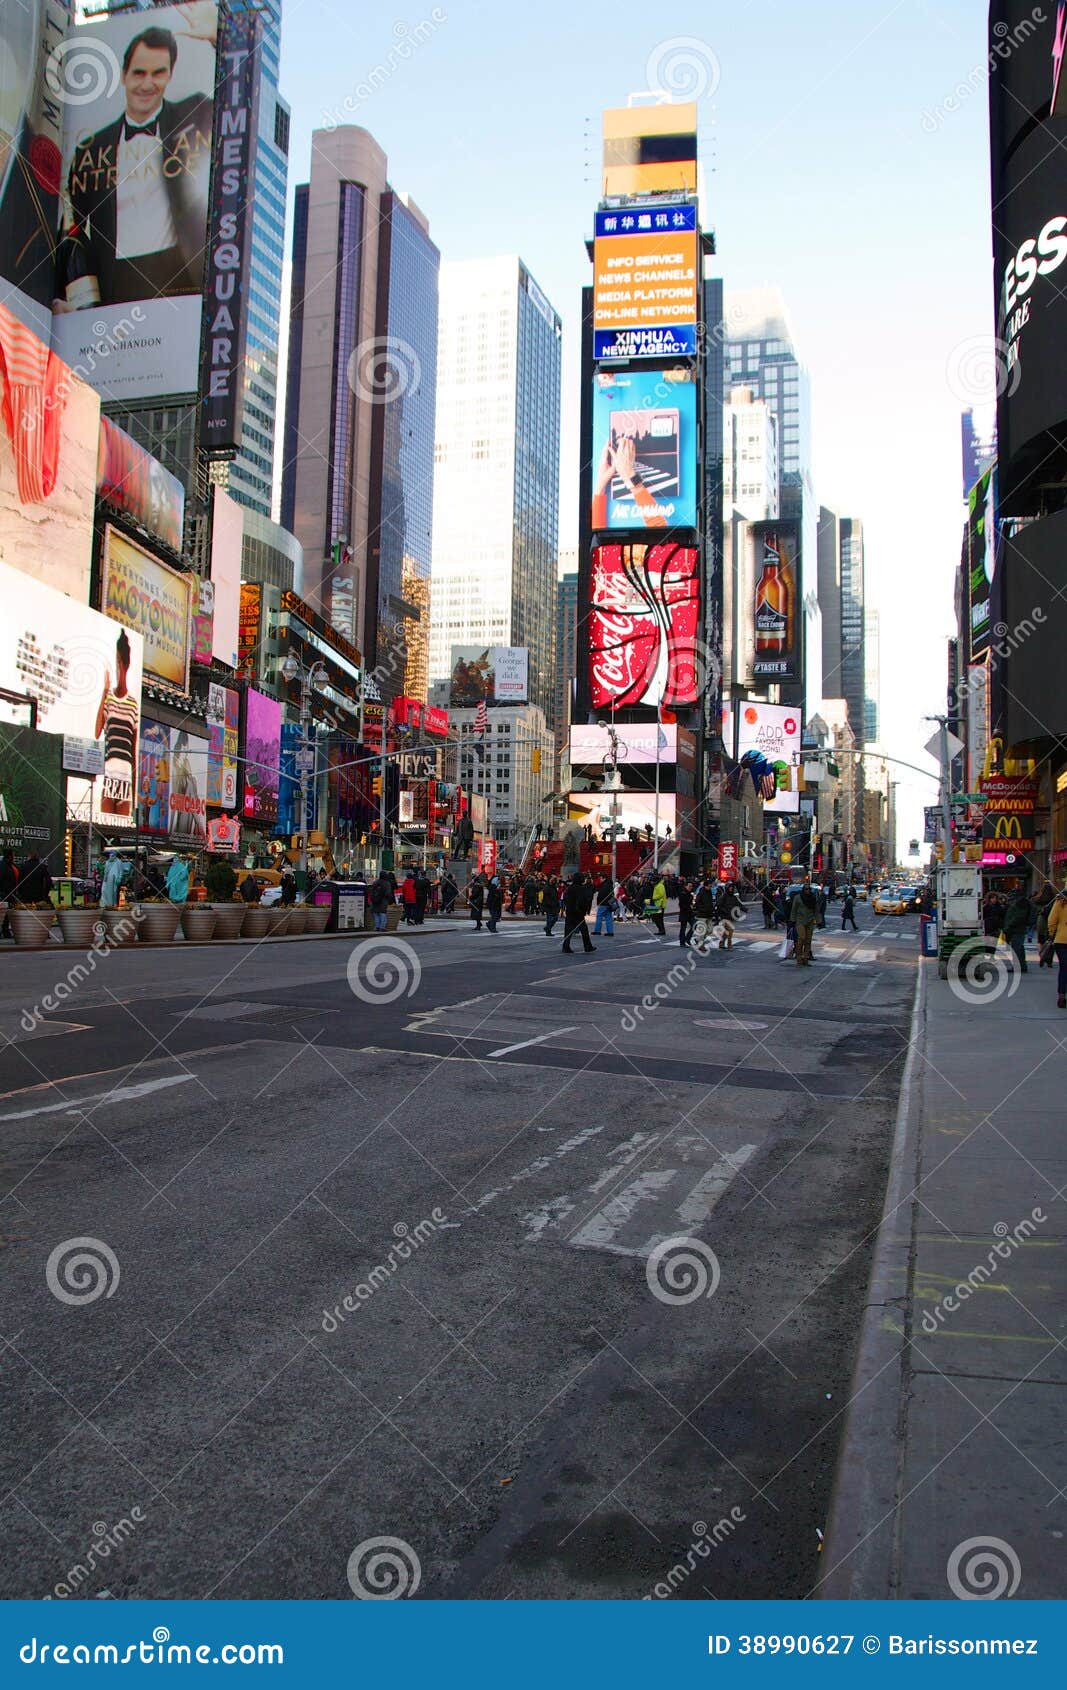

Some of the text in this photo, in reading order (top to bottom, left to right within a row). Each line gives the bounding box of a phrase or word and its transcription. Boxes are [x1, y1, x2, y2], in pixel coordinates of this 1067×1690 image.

[209, 50, 249, 397] TIMES SQUARE
[607, 253, 684, 268] INFO SERVICE
[598, 269, 695, 285] NEWS CHANNELS
[597, 287, 693, 302] MEDIA PLATFORM
[595, 304, 696, 320] ON-LINE NETWORK
[615, 330, 675, 345] XINHUA
[602, 342, 688, 357] NEWS AGENCY
[207, 418, 227, 430] NYC
[106, 574, 184, 646] MOTOWN
[757, 724, 784, 739] ADD
[389, 754, 433, 776] HEY'S
[103, 777, 130, 801] REAL
[983, 782, 1036, 790] McDonald's
[170, 792, 207, 817] CHICAGO
[953, 888, 974, 896] JLG
